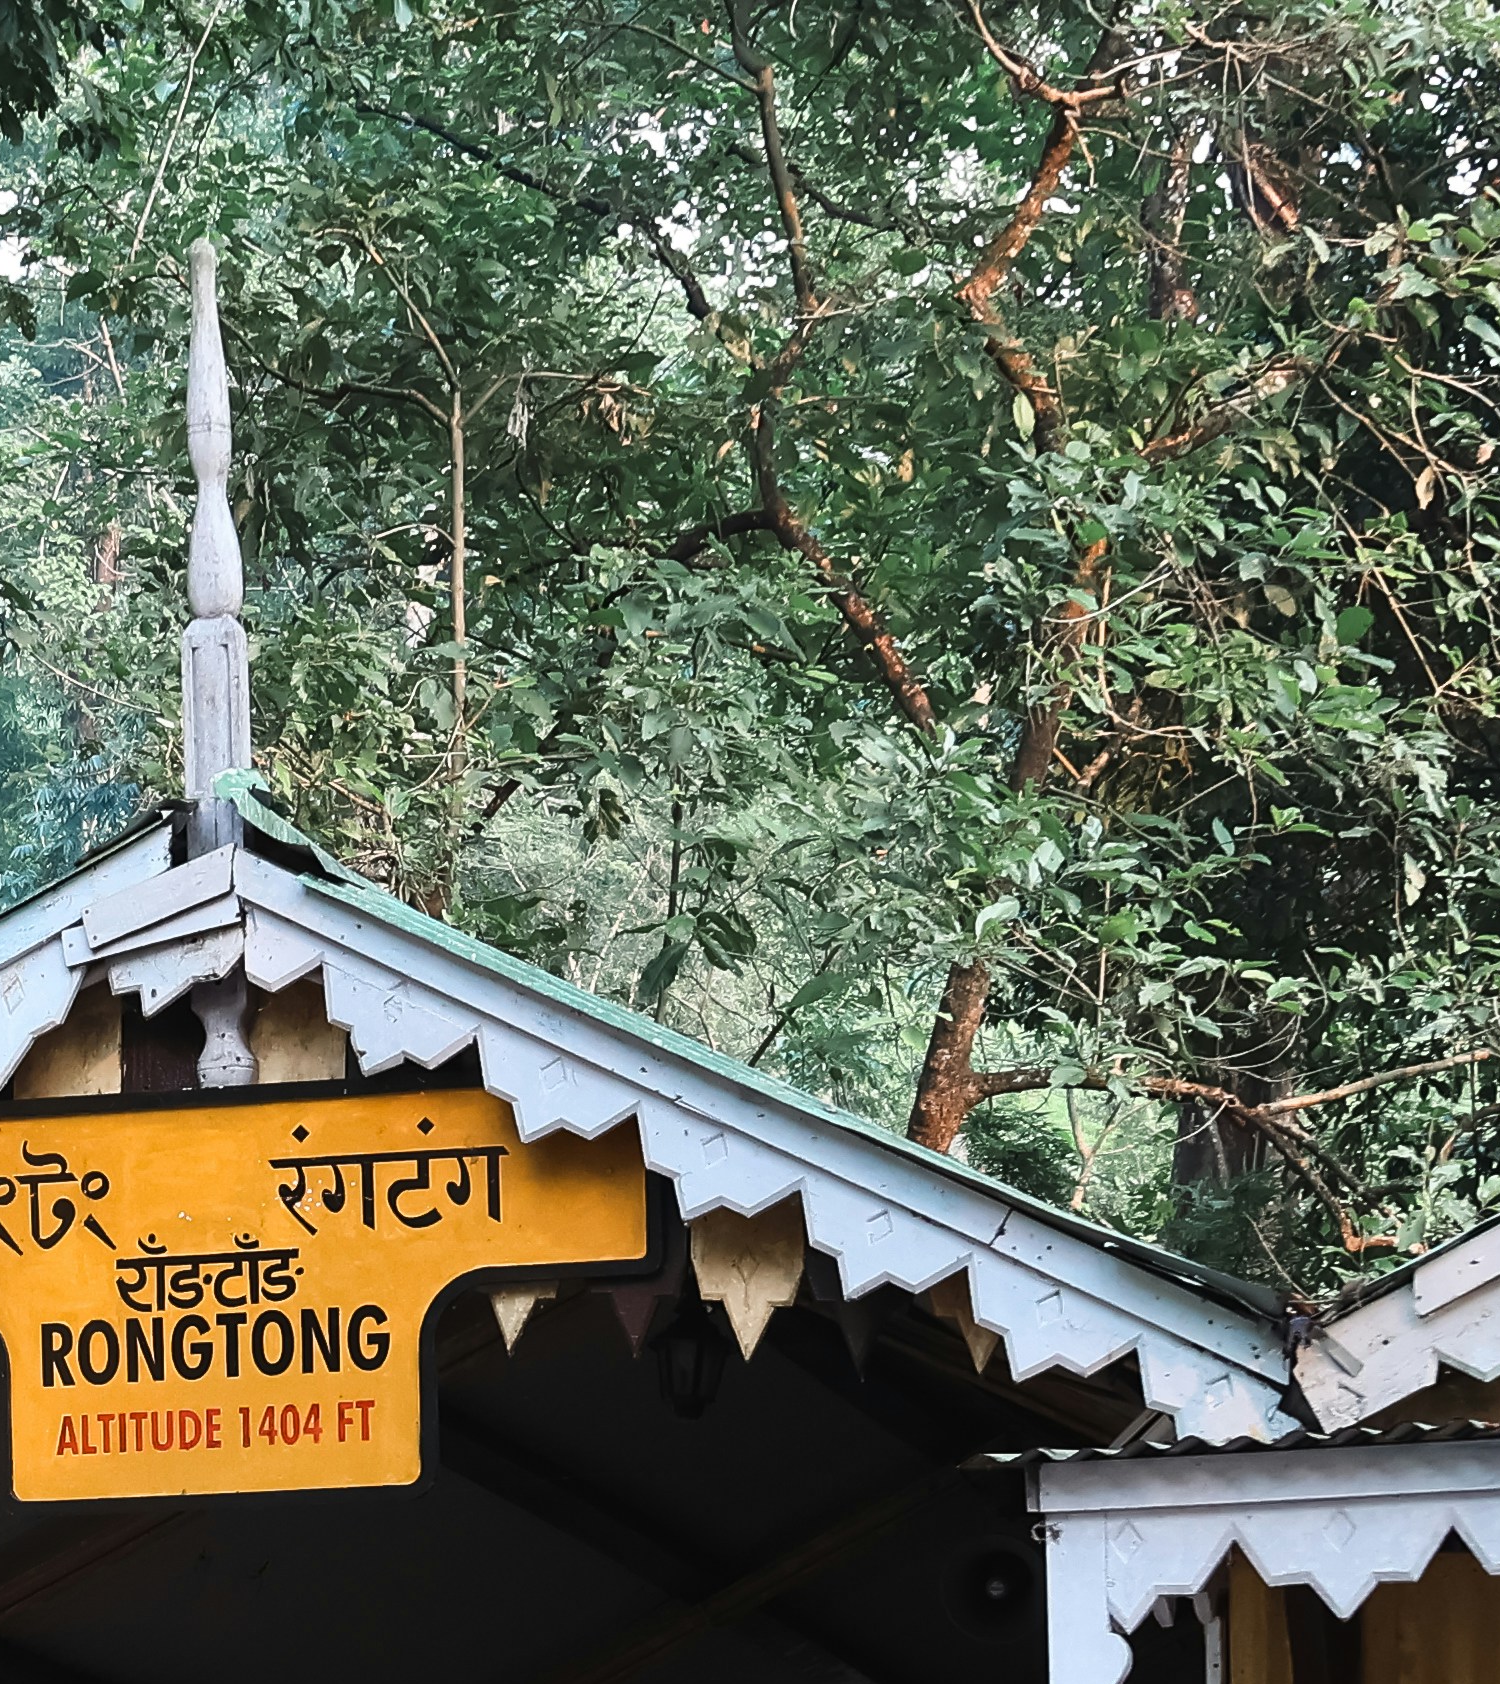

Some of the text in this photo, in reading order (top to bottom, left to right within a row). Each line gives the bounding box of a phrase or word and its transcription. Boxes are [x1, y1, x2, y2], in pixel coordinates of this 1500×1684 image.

[269, 1117, 509, 1236] रंगटंग
[41, 1305, 391, 1388] RONGTONG
[56, 1400, 376, 1456] ALTITUDE 1404 FT
